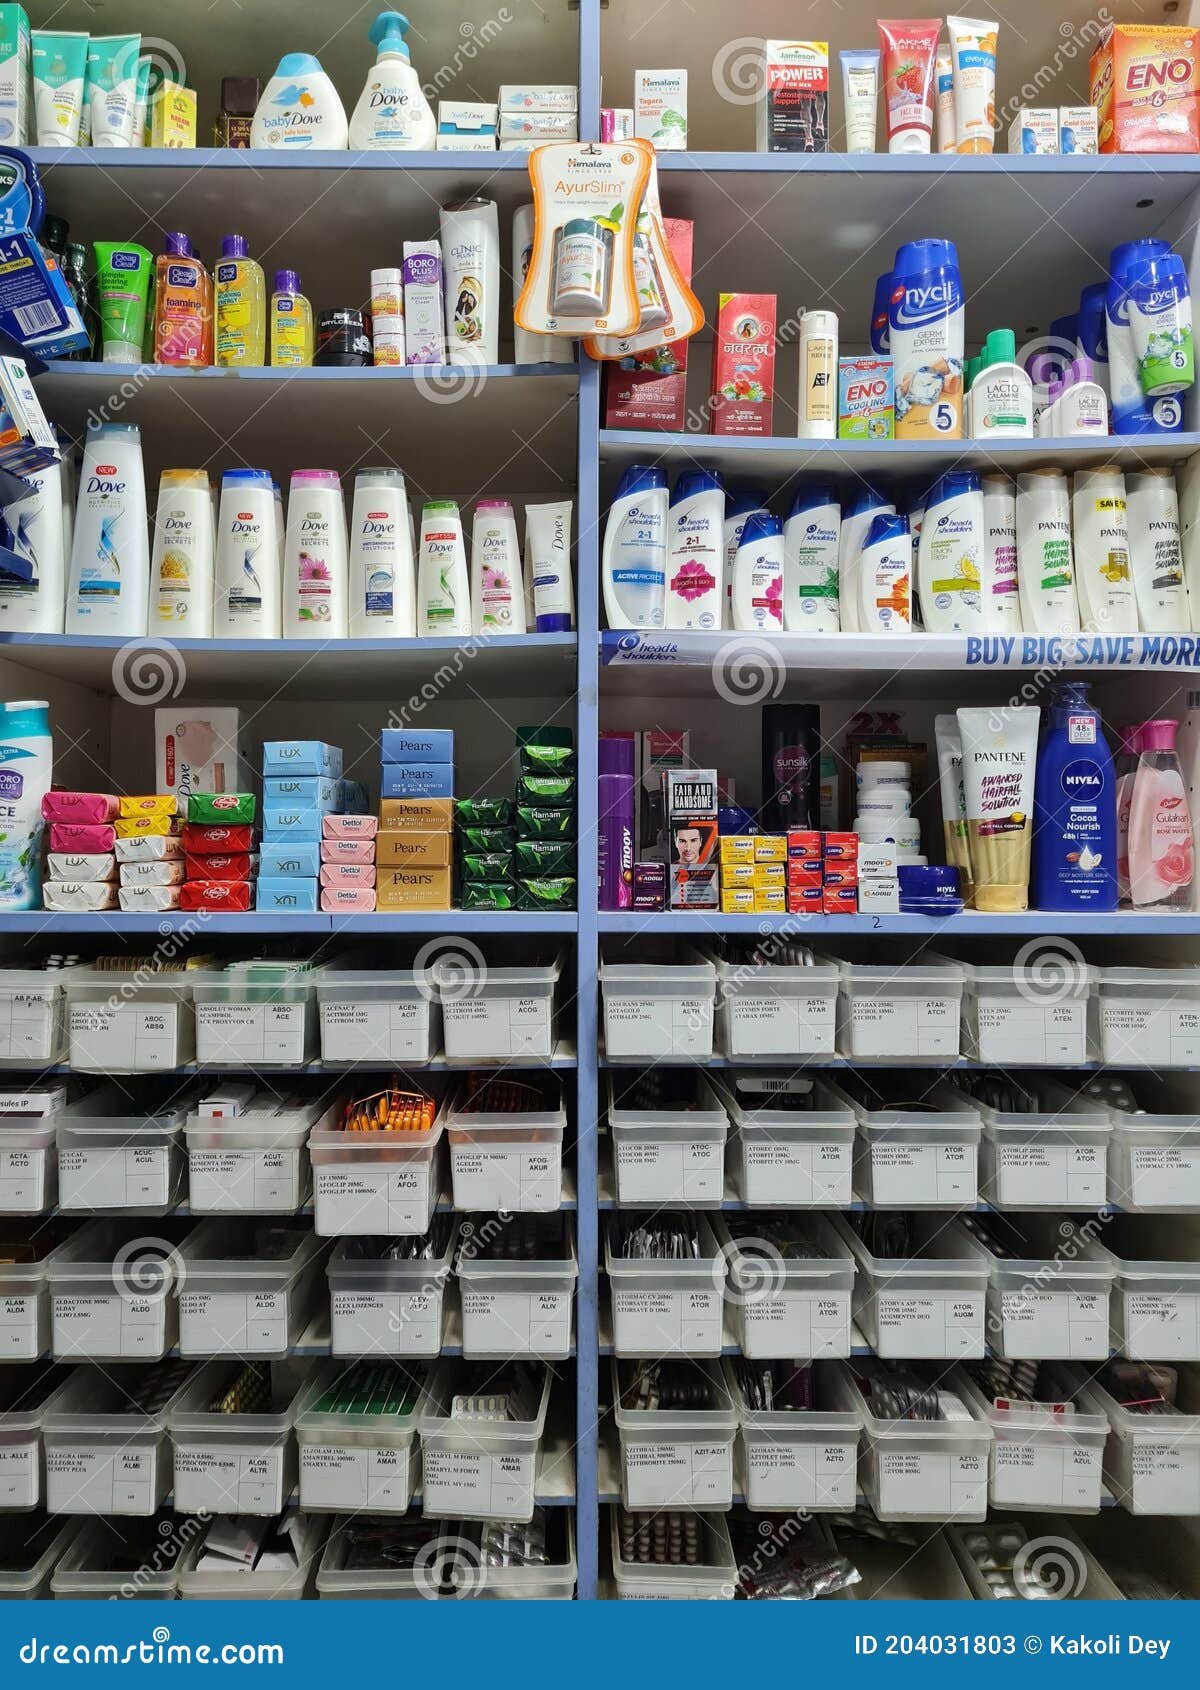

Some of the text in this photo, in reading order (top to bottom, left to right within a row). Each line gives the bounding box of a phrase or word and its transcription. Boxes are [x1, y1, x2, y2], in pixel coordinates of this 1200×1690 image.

[780, 51, 816, 61] Jamieson
[771, 67, 824, 82] POWER
[1126, 58, 1192, 93] ENO
[642, 78, 680, 87] Himalaya
[1092, 62, 1112, 100] ENO
[382, 87, 406, 96] baby
[773, 92, 817, 100] Testosterone
[370, 92, 408, 107] Dove
[639, 97, 663, 106] Tagara
[773, 98, 801, 106] Support
[263, 112, 323, 129] baby Dove
[568, 158, 612, 168] Himalaya
[555, 180, 622, 196] AyurSlim
[451, 245, 482, 256] CLINIC
[115, 254, 136, 262] Clean
[408, 259, 435, 268] BORO
[115, 261, 136, 270] Clear
[102, 272, 125, 280] pimple
[411, 268, 433, 276] PLUS
[102, 278, 128, 286] clearing
[906, 282, 952, 308] nycil
[1150, 288, 1178, 303] nycil
[166, 298, 200, 310] foaming
[918, 331, 942, 339] GERM
[914, 338, 945, 348] EXPERT
[724, 342, 768, 356] नवरत्न
[847, 381, 888, 402] ENO
[987, 385, 1020, 394] LACTO
[848, 398, 886, 412] COOLING
[936, 405, 952, 430] 5
[87, 477, 126, 493] Dove
[1100, 500, 1119, 508] SAVE
[165, 518, 192, 530] Dove
[232, 520, 260, 533] Dove
[362, 520, 394, 534] Dove
[678, 524, 710, 532] shoulders
[552, 521, 564, 550] Dove
[938, 526, 972, 534] shoulders
[483, 537, 507, 548] Dove
[638, 642, 678, 653] head&
[966, 636, 1200, 667] BUY BIG, SAVE MORE
[621, 651, 678, 662] shoulders
[400, 740, 434, 751] Pears
[280, 748, 302, 758] LUX
[974, 752, 1026, 762] PANTENE
[776, 757, 808, 768] sunsilk
[178, 764, 191, 796] Dove
[981, 773, 1022, 788] ADVANCED
[1066, 776, 1100, 786] NIVEA
[674, 784, 712, 796] FAIR AND
[982, 786, 1022, 800] HAIRFALL
[61, 796, 84, 806] LUX
[674, 796, 712, 808] HANDSOME
[981, 797, 1020, 812] SOLUTION
[400, 804, 432, 815] Pears
[532, 811, 560, 819] Hamam
[278, 816, 302, 825] LUX
[1070, 814, 1097, 822] Cocoa
[1066, 822, 1100, 831] Nourish
[622, 826, 632, 869] moov
[392, 873, 432, 884] Pears
[62, 884, 84, 894] LUX
[937, 886, 956, 894] NIVEA
[872, 917, 882, 928] 2
[500, 1456, 522, 1464] AMAR-
